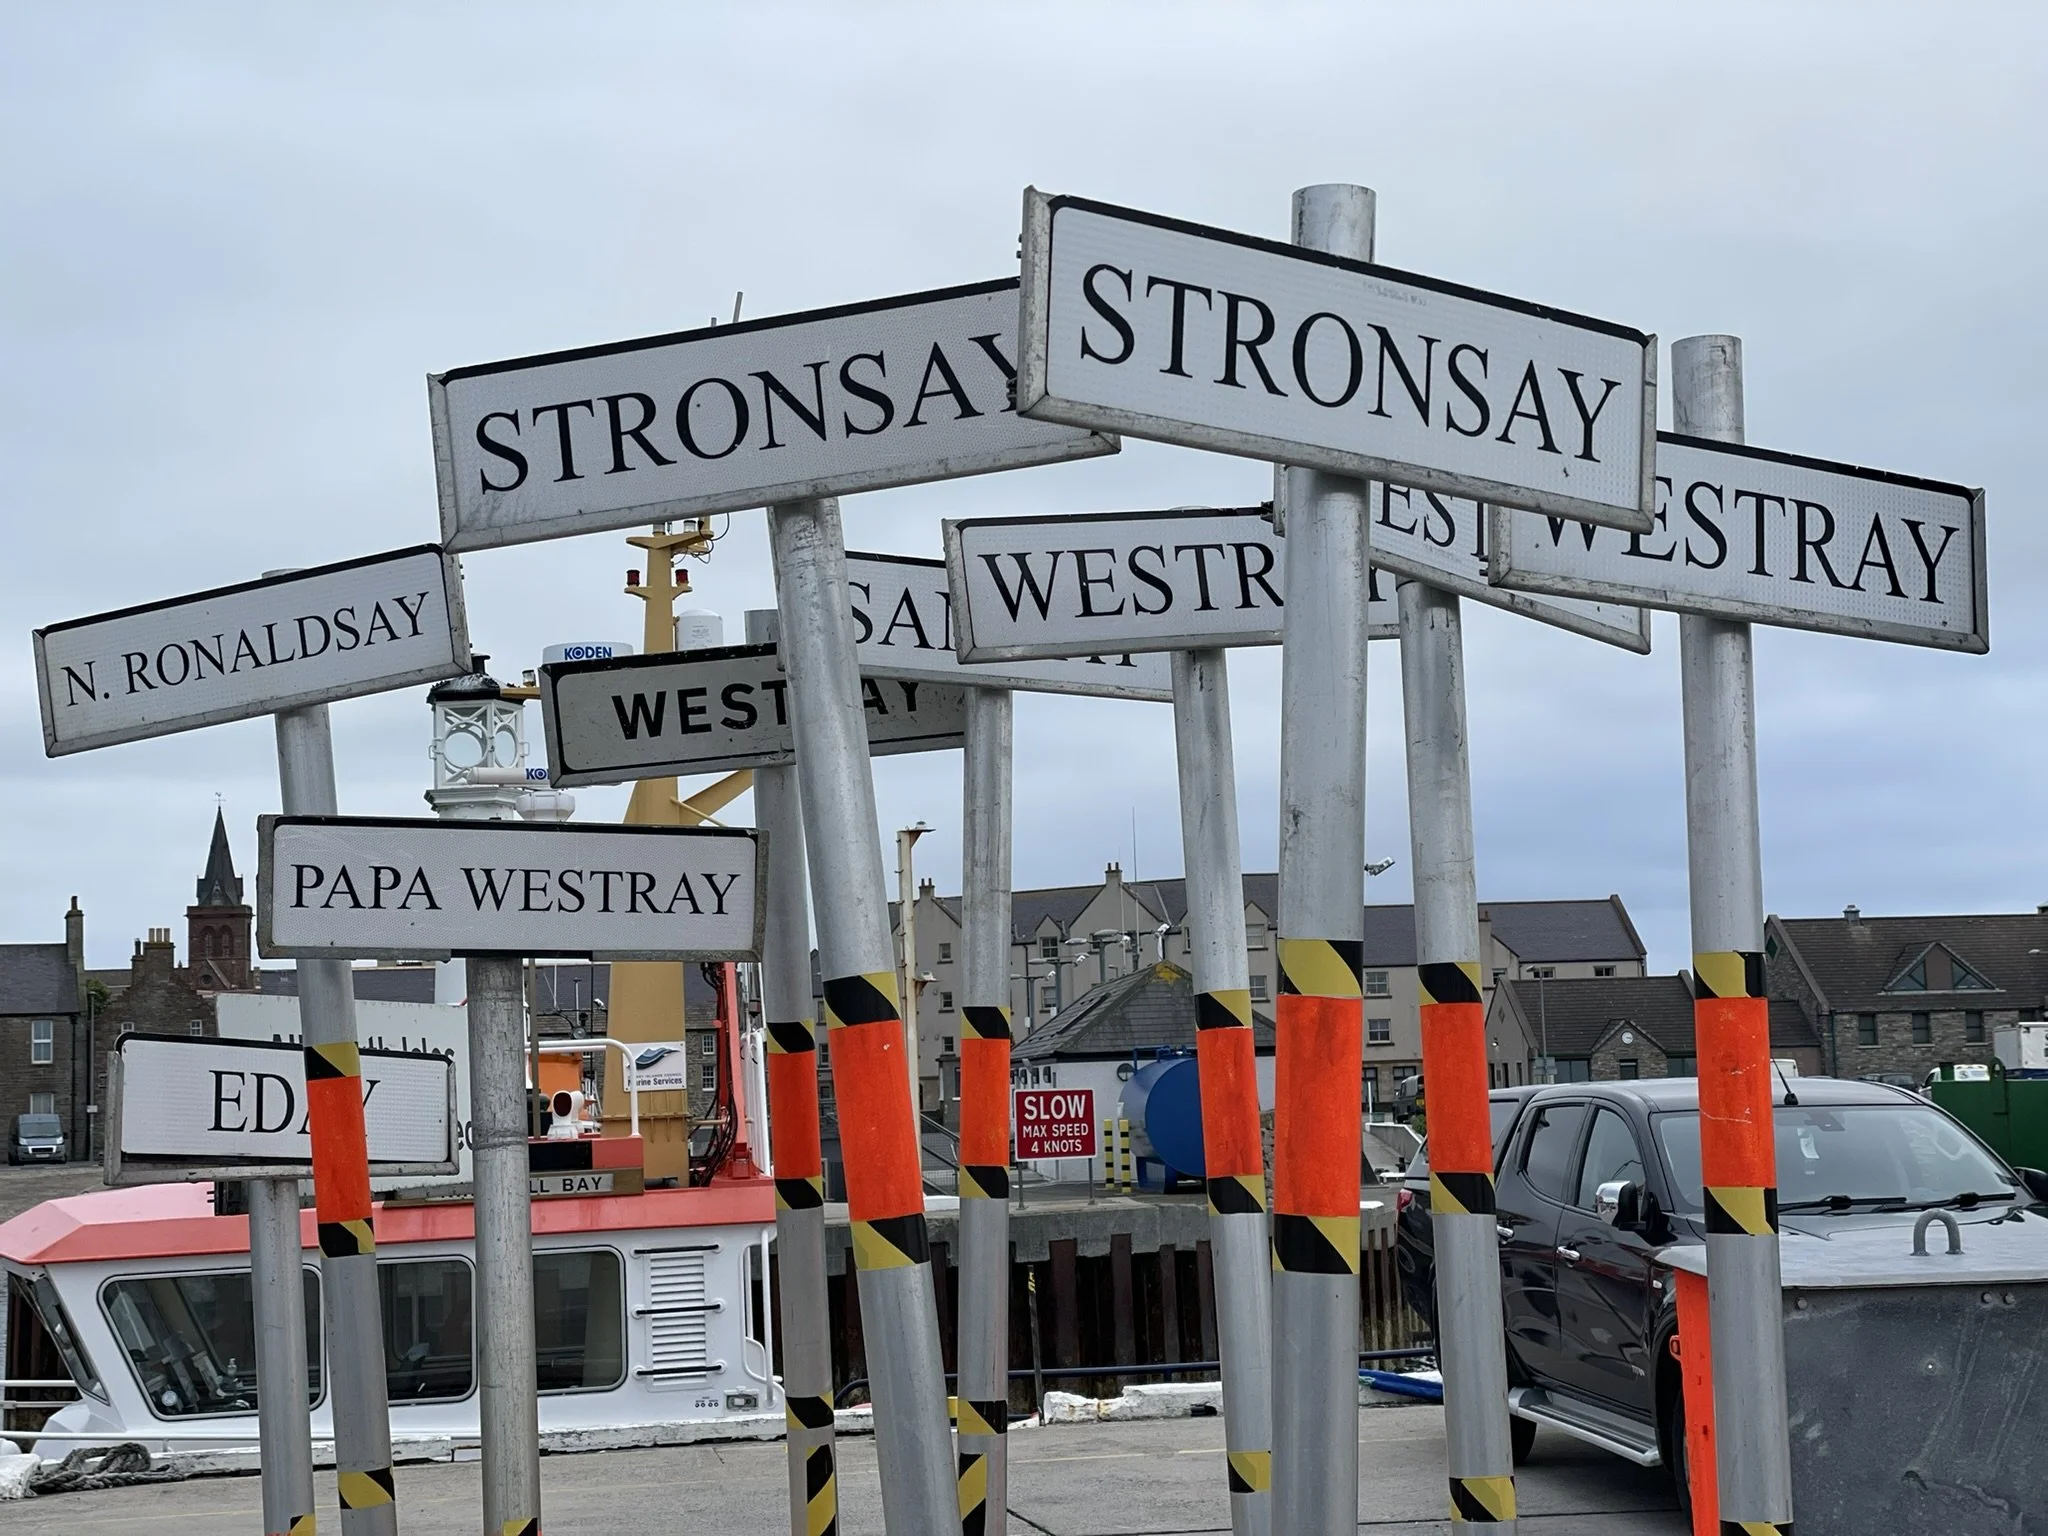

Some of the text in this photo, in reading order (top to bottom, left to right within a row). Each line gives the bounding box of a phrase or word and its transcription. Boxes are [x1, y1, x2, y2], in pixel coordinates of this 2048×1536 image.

[1080, 263, 1622, 463] STRONSAY
[977, 541, 1388, 623] WESTR
[60, 591, 430, 707] N. RONALDSAY
[564, 646, 612, 661] KODEN
[611, 678, 919, 741] WESTAY
[289, 863, 741, 915] PAPA WESTRAY
[628, 1077, 682, 1087] rine Services
[207, 1069, 381, 1135] ED
[1024, 1095, 1086, 1120] SLOW
[1023, 1123, 1089, 1138] MAX SPEED
[1031, 1139, 1082, 1153] 4 KNOTS
[562, 1176, 602, 1192] BAY
